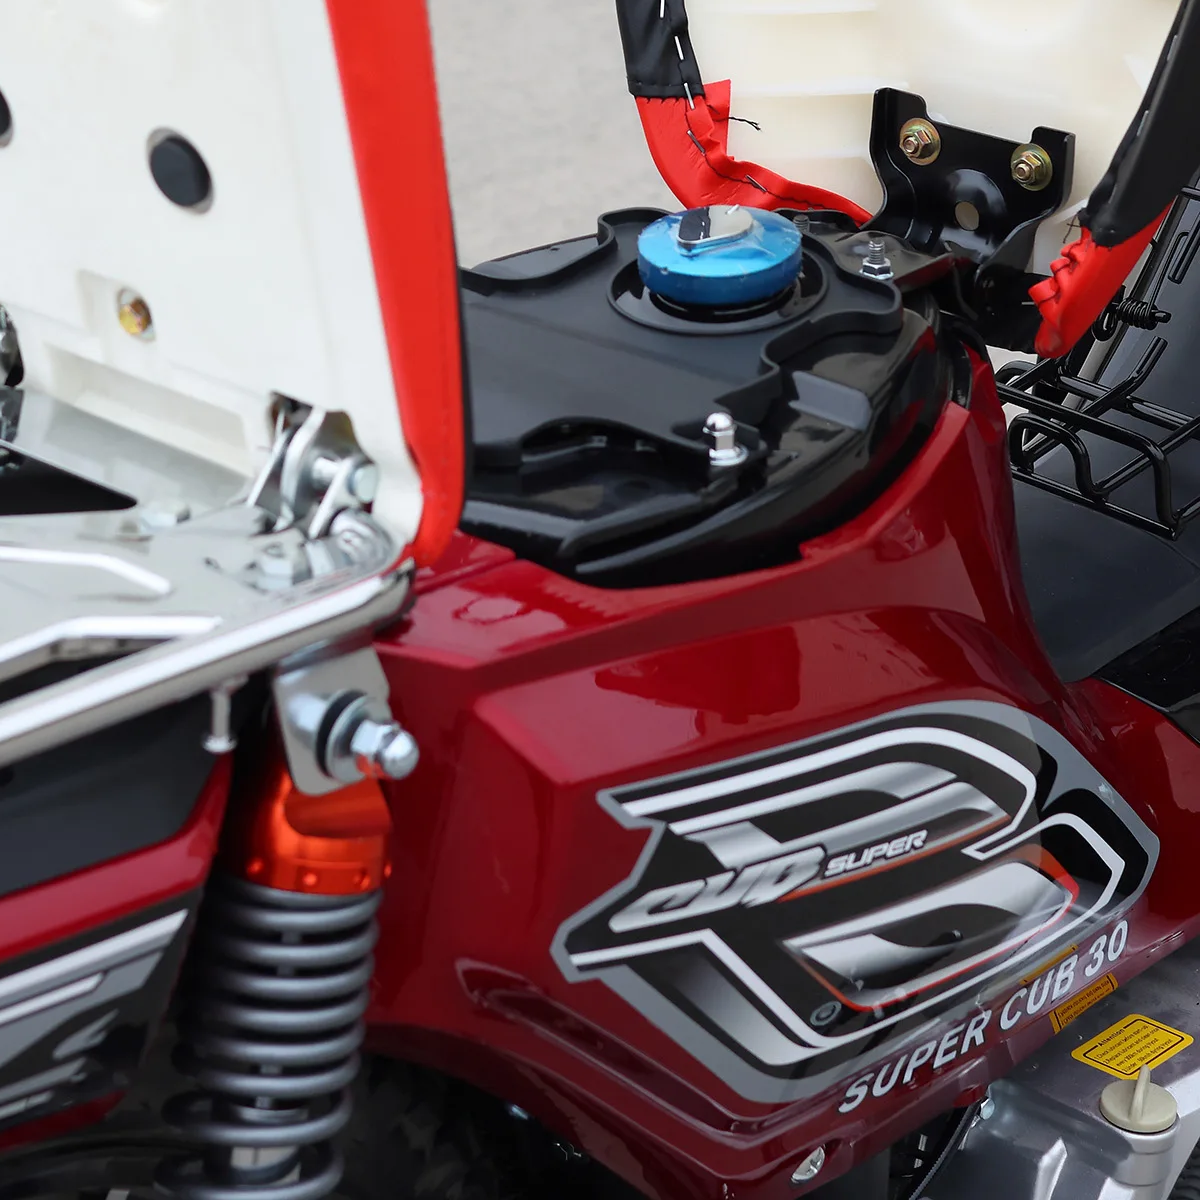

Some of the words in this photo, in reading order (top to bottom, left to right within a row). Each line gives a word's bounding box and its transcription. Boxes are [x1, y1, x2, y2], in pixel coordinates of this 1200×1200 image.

[823, 828, 929, 878] SUPER
[838, 1008, 993, 1114] SUPER
[999, 953, 1079, 1031] CUB
[1084, 920, 1129, 978] 30
